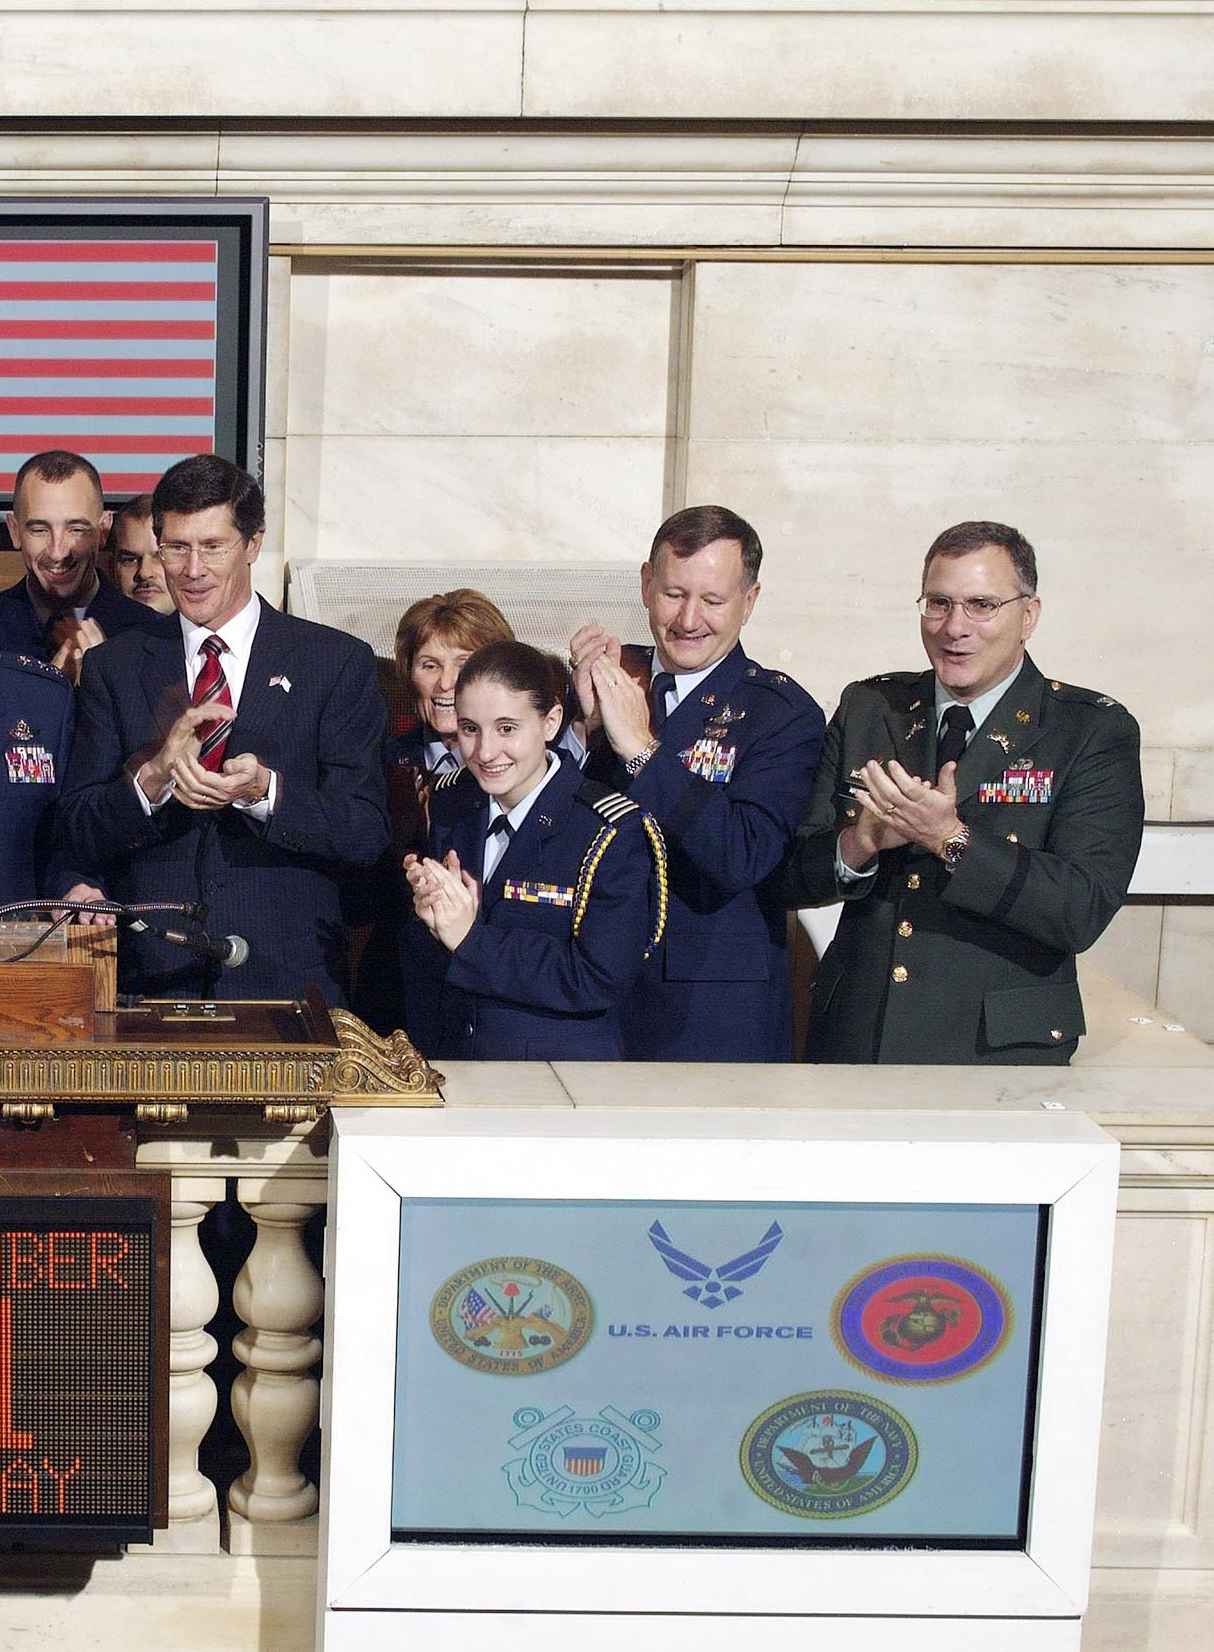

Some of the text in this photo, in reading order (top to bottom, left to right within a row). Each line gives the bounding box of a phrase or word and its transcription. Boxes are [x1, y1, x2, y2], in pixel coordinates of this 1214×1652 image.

[440, 1260, 507, 1308] DEPARTMENT
[513, 1260, 530, 1270] OF
[608, 1325, 814, 1339] U.S. AIR FORCE
[756, 1402, 827, 1448] DEPARTMENT
[834, 1402, 852, 1411] OF
[536, 1423, 635, 1491] UNITED STATES COAST GUARD
[569, 1484, 599, 1494] 1790
[785, 1493, 832, 1510] STATES
